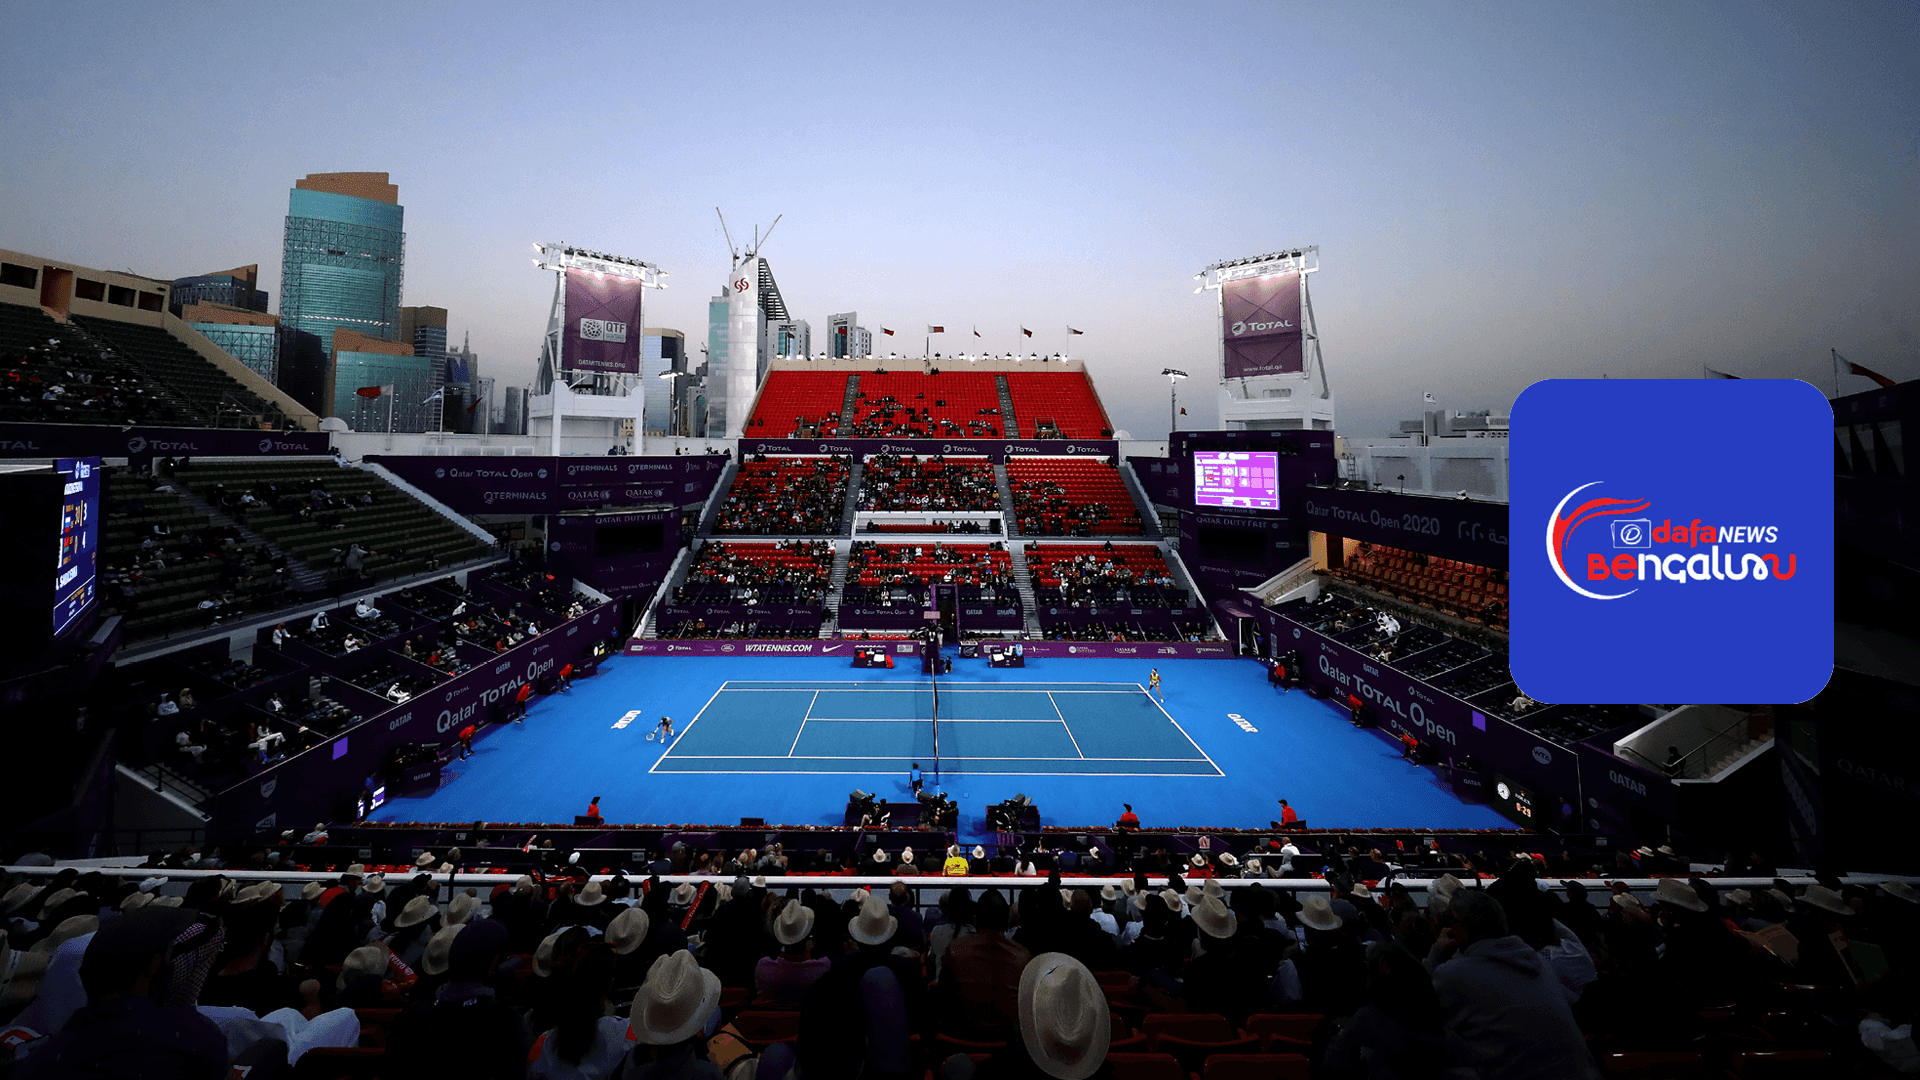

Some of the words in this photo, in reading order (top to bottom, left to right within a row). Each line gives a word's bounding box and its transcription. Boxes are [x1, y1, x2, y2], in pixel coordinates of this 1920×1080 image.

[606, 322, 625, 333] QTF
[1248, 320, 1293, 331] TOTAL
[150, 440, 198, 450] TOTAL
[274, 441, 309, 450] TOTAL
[450, 468, 473, 478] Qatar
[476, 470, 508, 478] TOTAL
[510, 468, 533, 479] Open
[567, 464, 618, 476] QTERMINALS
[628, 463, 673, 474] QTERMINALS
[484, 491, 547, 504] QTERMINALS
[568, 490, 599, 500] QATAR
[595, 516, 622, 524] QATAR
[1196, 516, 1221, 525] QATAR
[1248, 520, 1267, 528] FREE
[1306, 500, 1329, 517] Qatar
[1331, 506, 1368, 523] TOTAL
[1370, 509, 1400, 529] Open
[1402, 513, 1440, 535] 2020
[745, 644, 812, 653] WTATENNIS.COM
[437, 700, 477, 734] Qatar
[479, 675, 525, 707] TOTAL
[527, 658, 553, 681] Open
[453, 686, 470, 697] TOTAL
[1318, 654, 1350, 687] Qatar
[1353, 674, 1407, 719] TOTAL
[1409, 702, 1457, 746] Open
[1415, 689, 1435, 706] TOTAL
[389, 711, 412, 731] QATAR
[413, 771, 431, 781] QATAR
[1837, 758, 1906, 791] QATAR
[1463, 778, 1482, 787] QATAR
[1609, 769, 1647, 797] QATAR
